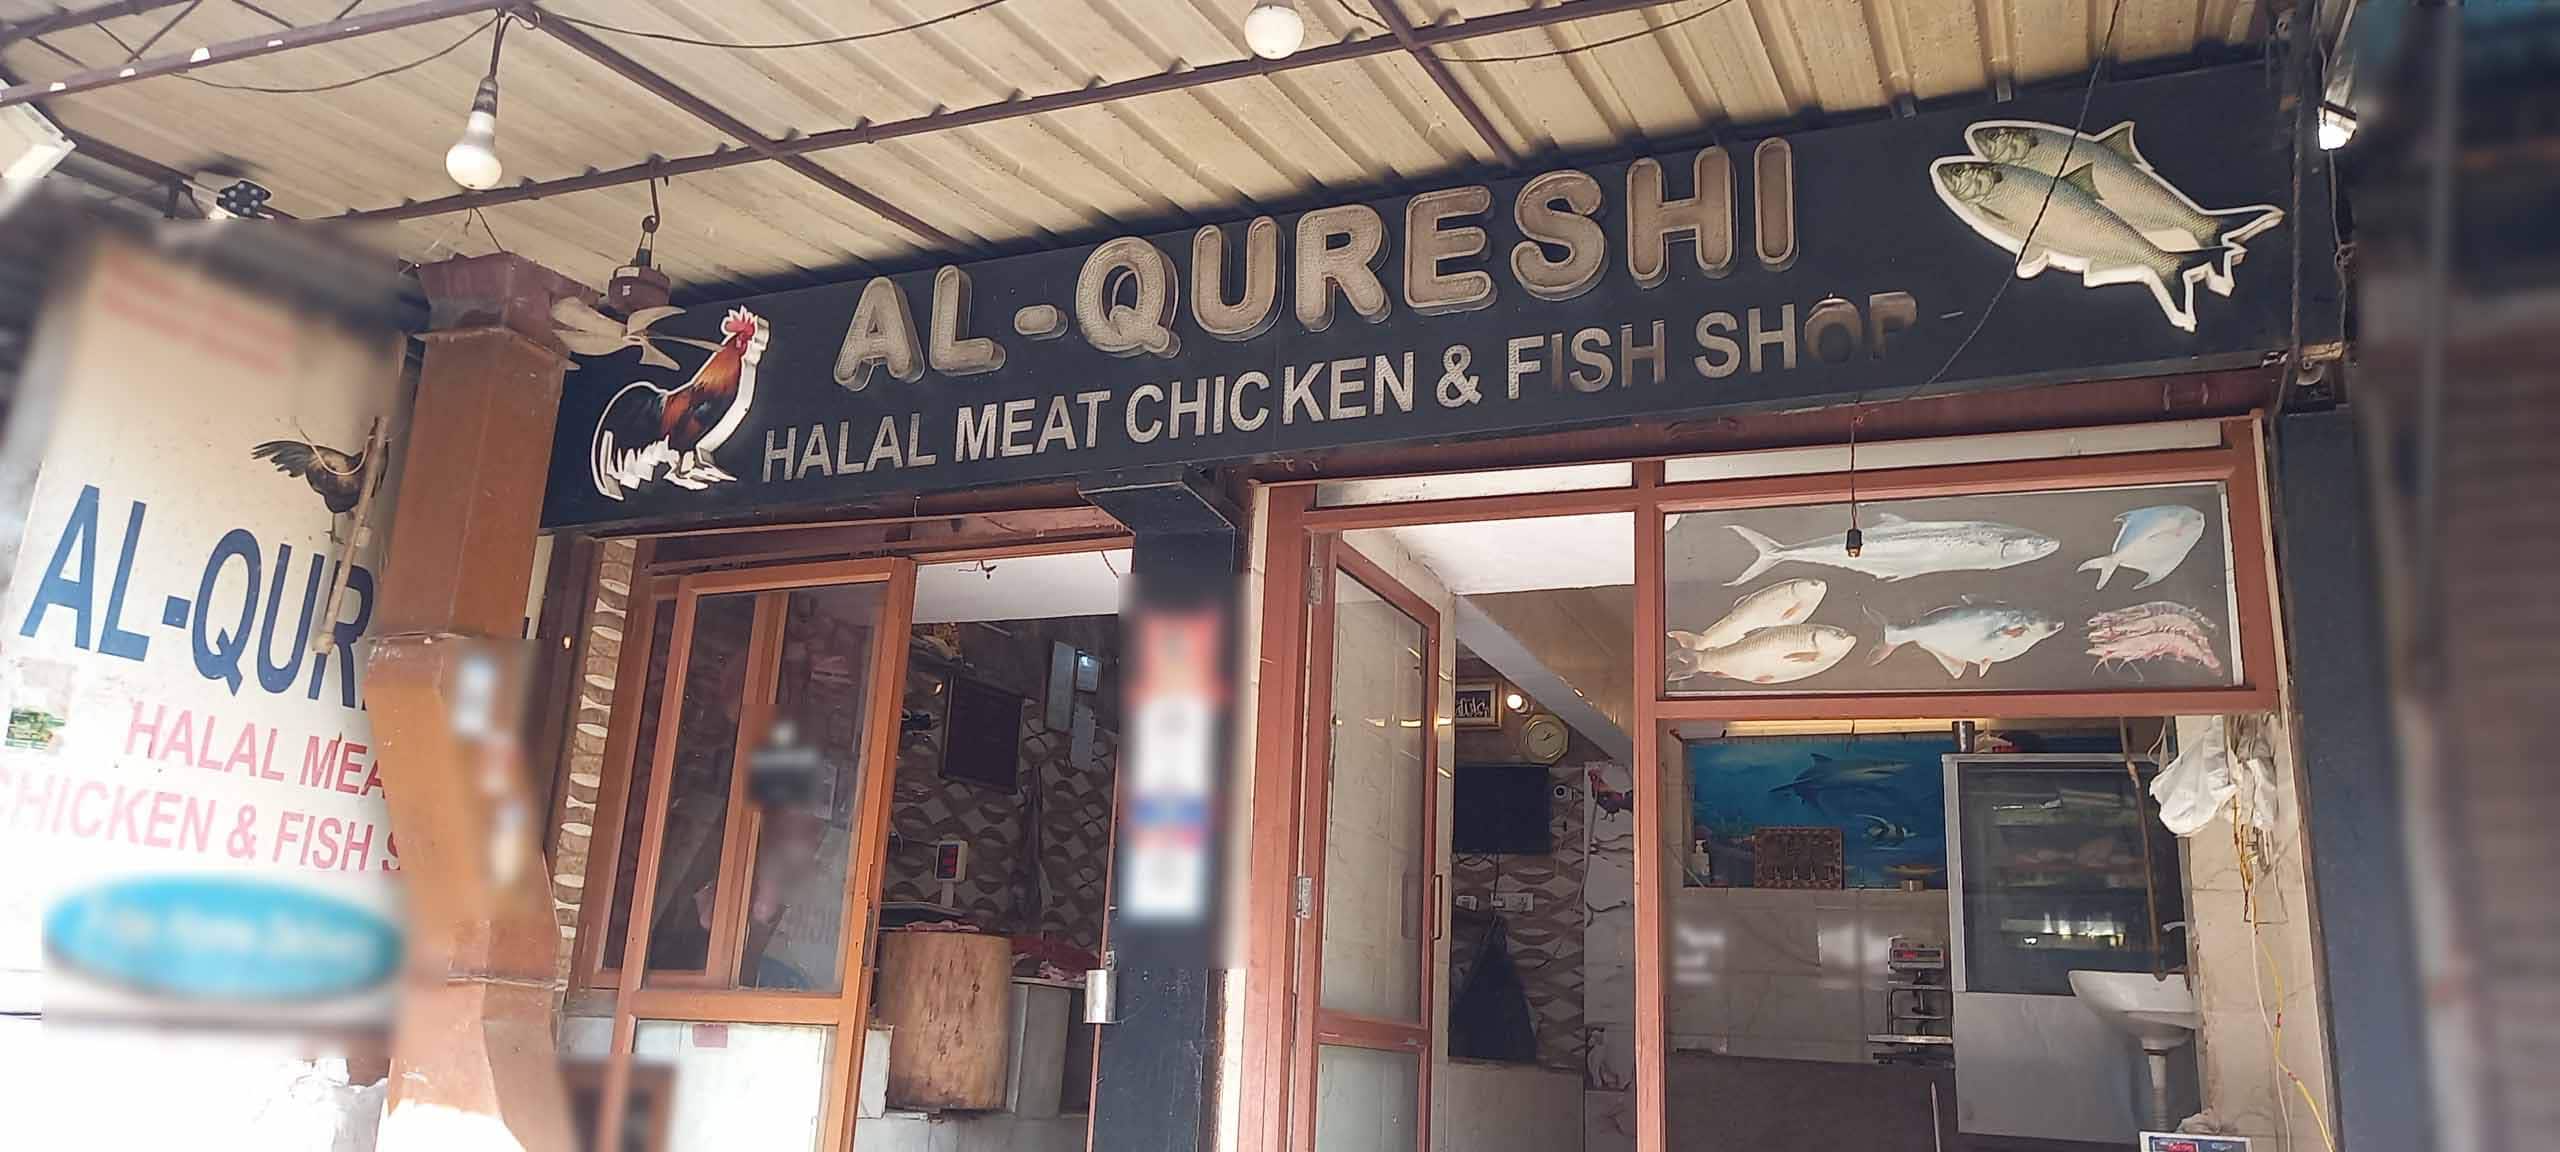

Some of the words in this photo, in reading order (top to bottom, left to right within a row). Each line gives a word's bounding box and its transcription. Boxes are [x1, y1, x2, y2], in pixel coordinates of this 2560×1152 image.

[832, 135, 1799, 392] AL-QURESHI
[761, 412, 938, 483] HALAL
[954, 390, 1111, 462] MEAT
[1124, 350, 1415, 444] CHICKEN
[1434, 344, 1482, 407] &
[1507, 319, 1666, 400] FISH
[1694, 290, 1918, 379] SHOP
[19, 483, 375, 711] AL-QUR
[0, 765, 219, 853] HICKEN
[226, 803, 258, 859] &
[272, 810, 375, 872] FISH
[124, 700, 286, 783] HALAL
